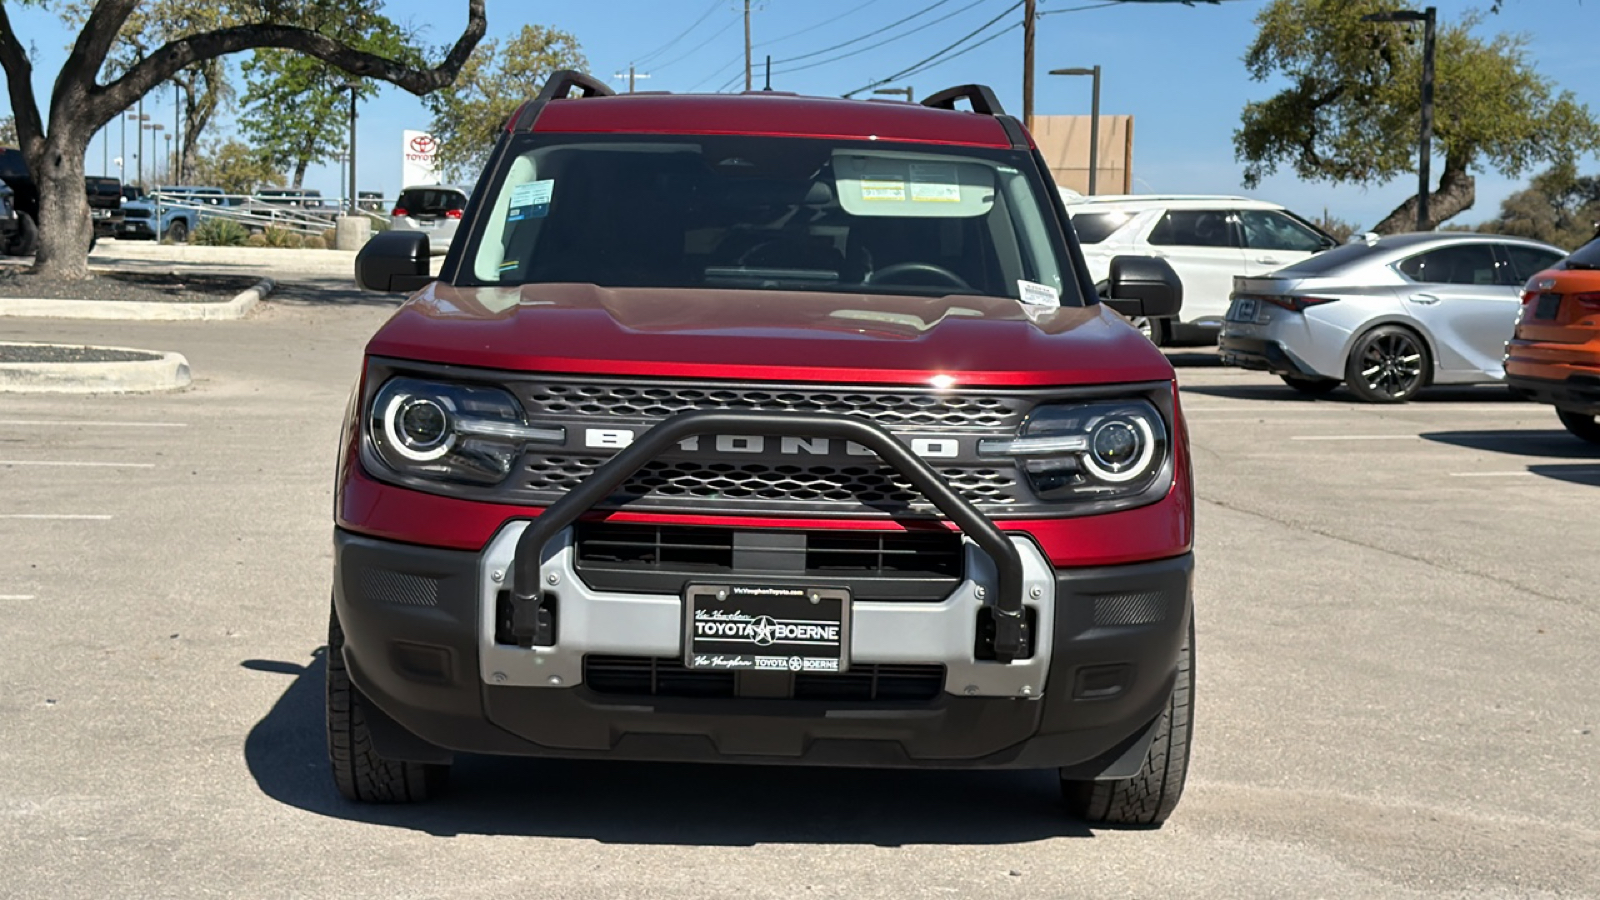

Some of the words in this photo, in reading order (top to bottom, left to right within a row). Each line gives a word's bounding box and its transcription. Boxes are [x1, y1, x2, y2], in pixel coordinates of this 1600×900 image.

[405, 153, 438, 162] TOYOT
[695, 621, 755, 636] TOYOTA
[776, 625, 840, 640] BOERNE
[755, 659, 788, 667] TOYOTA
[803, 659, 839, 670] BOERNE
